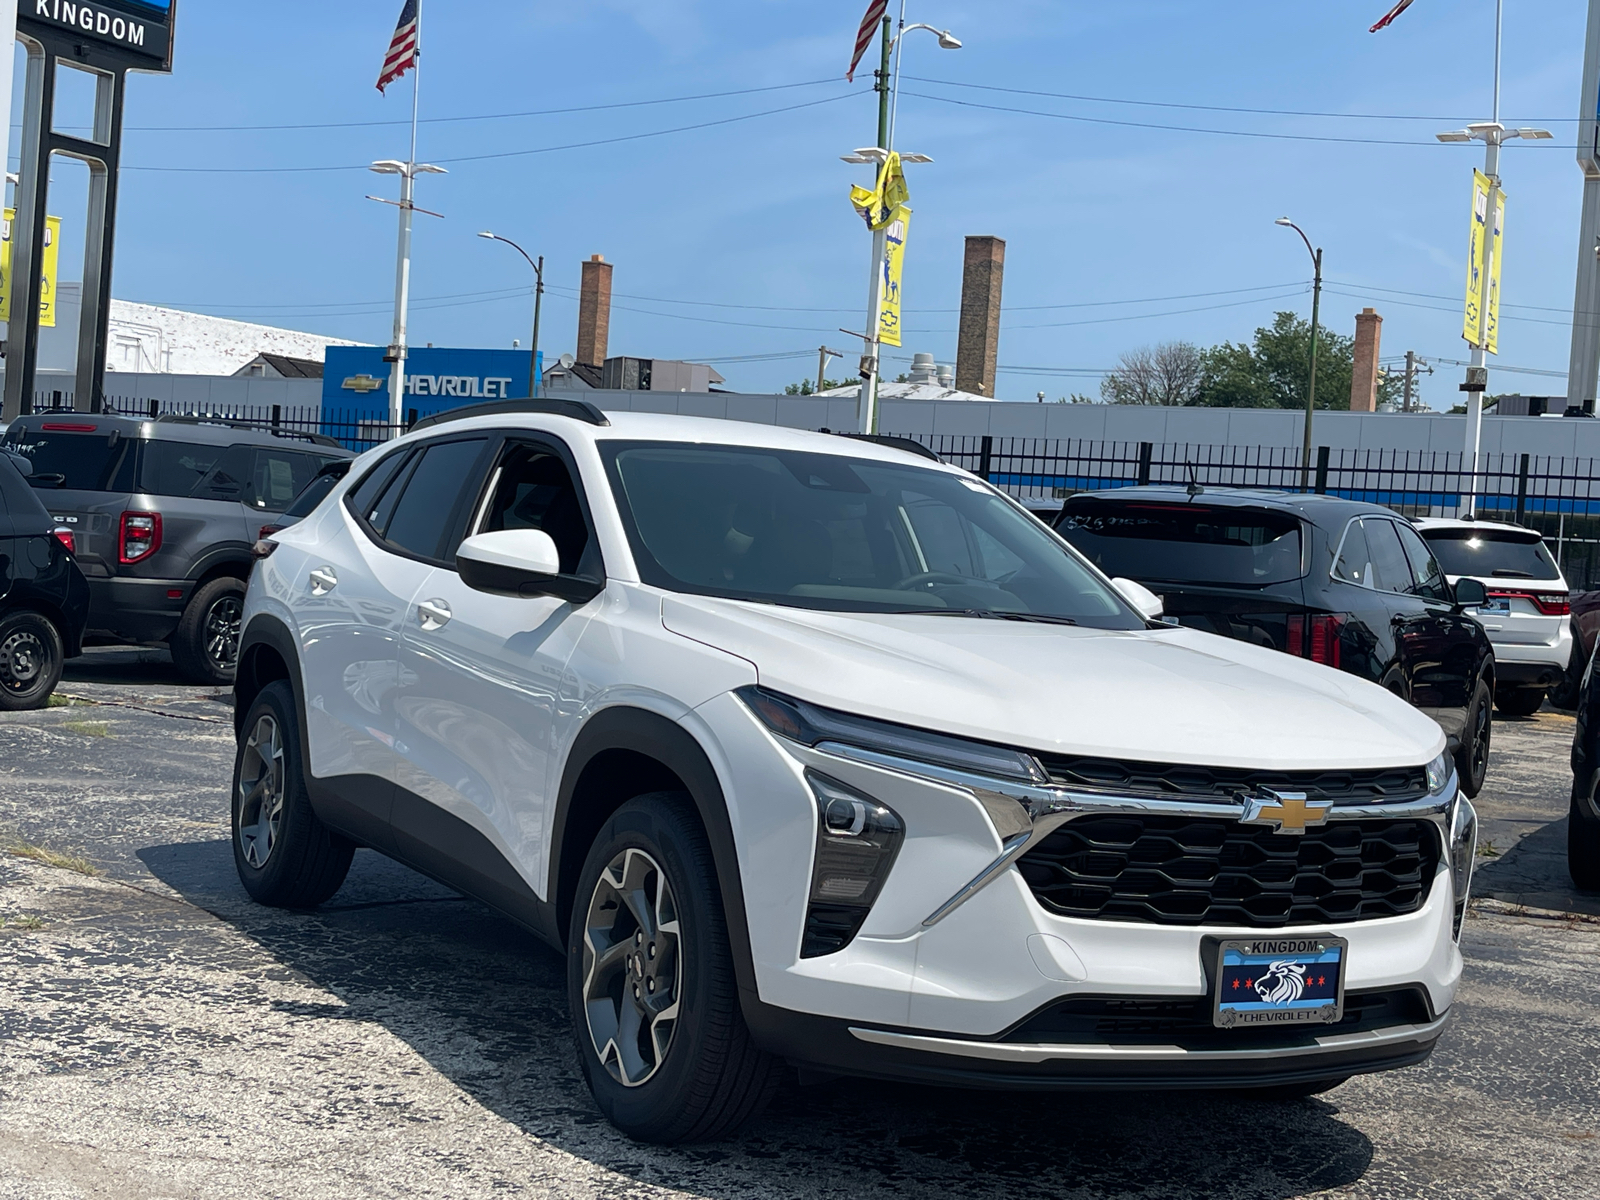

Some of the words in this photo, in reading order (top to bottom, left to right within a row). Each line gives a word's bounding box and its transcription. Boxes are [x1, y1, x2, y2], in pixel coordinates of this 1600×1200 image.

[36, 0, 145, 46] KINGDOM
[1251, 940, 1318, 954] KINGDOM
[1244, 1011, 1312, 1022] CHEVROLET
